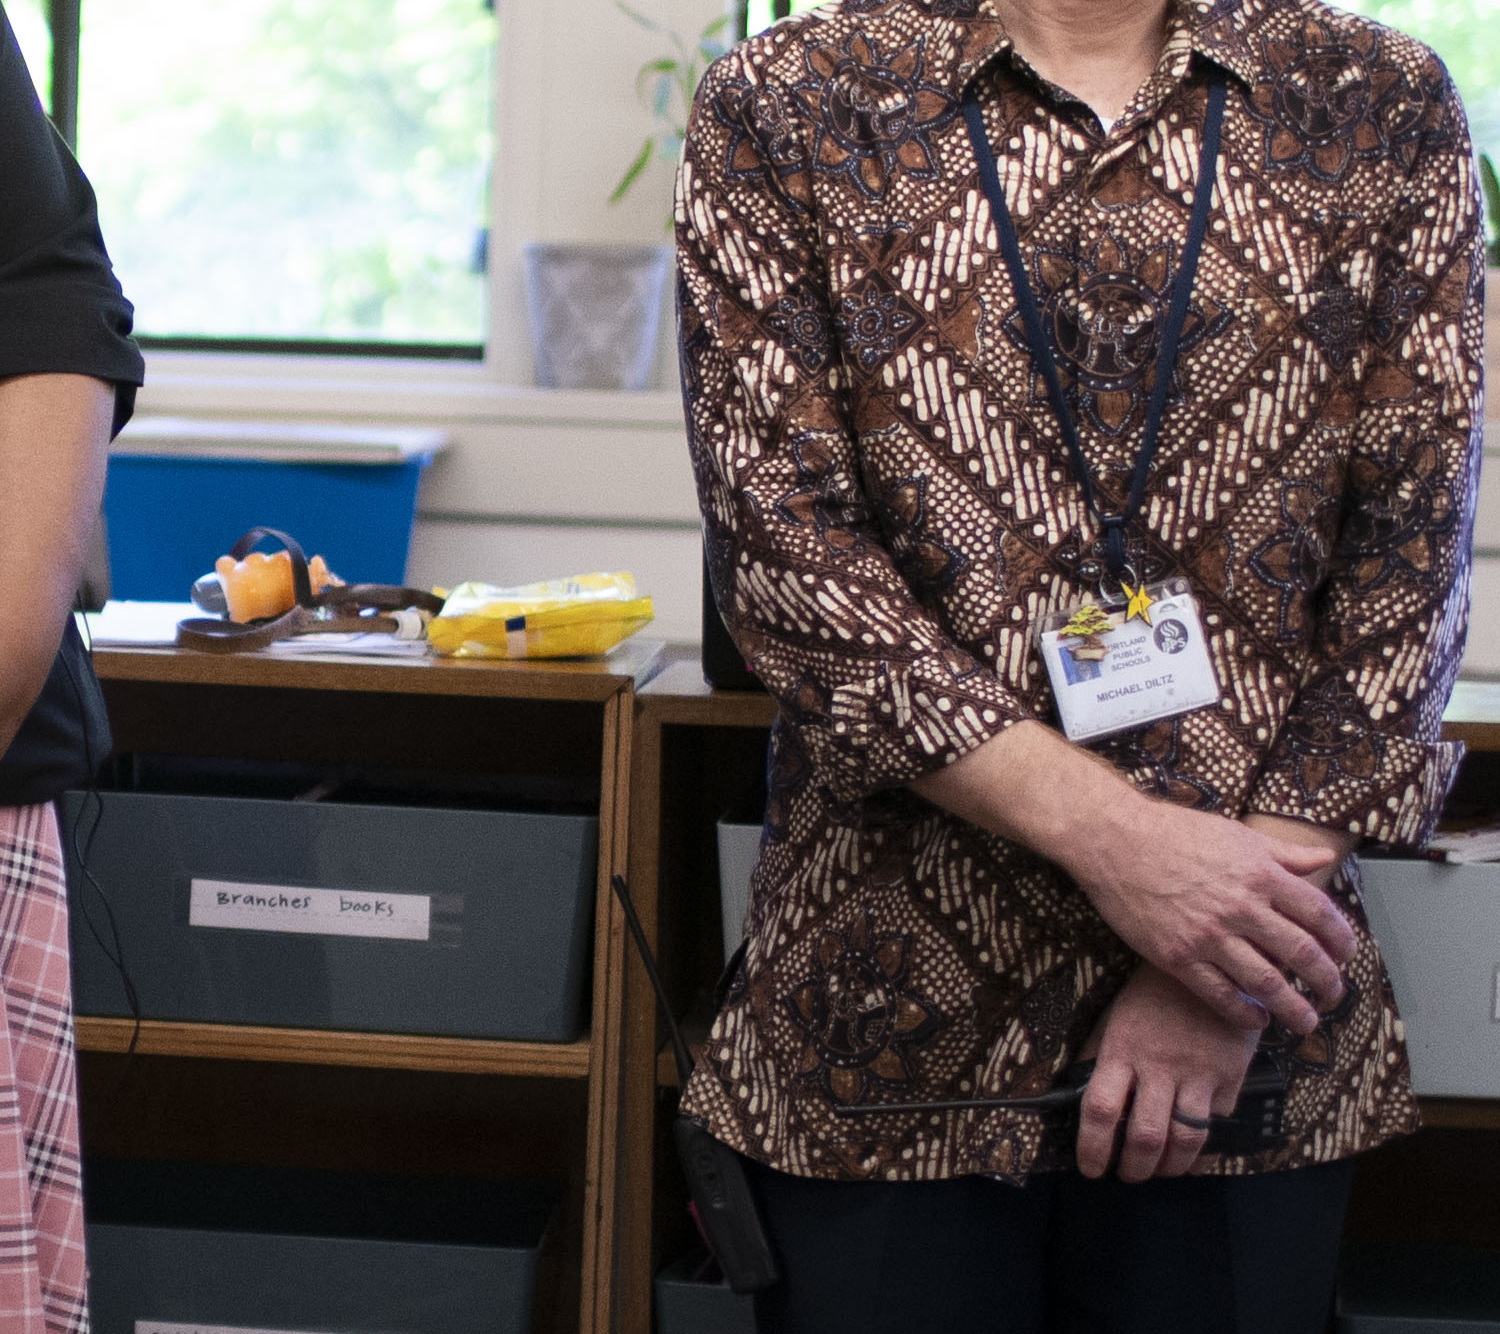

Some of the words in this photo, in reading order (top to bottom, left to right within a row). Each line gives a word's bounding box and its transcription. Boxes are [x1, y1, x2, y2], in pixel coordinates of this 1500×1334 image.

[1112, 655, 1151, 671] SCHOOLS
[1113, 647, 1142, 659] PUBLIC
[1097, 684, 1143, 703] MICHAEL
[1145, 674, 1174, 689] DILTZ
[217, 892, 311, 909] Branches
[340, 896, 394, 916] books
